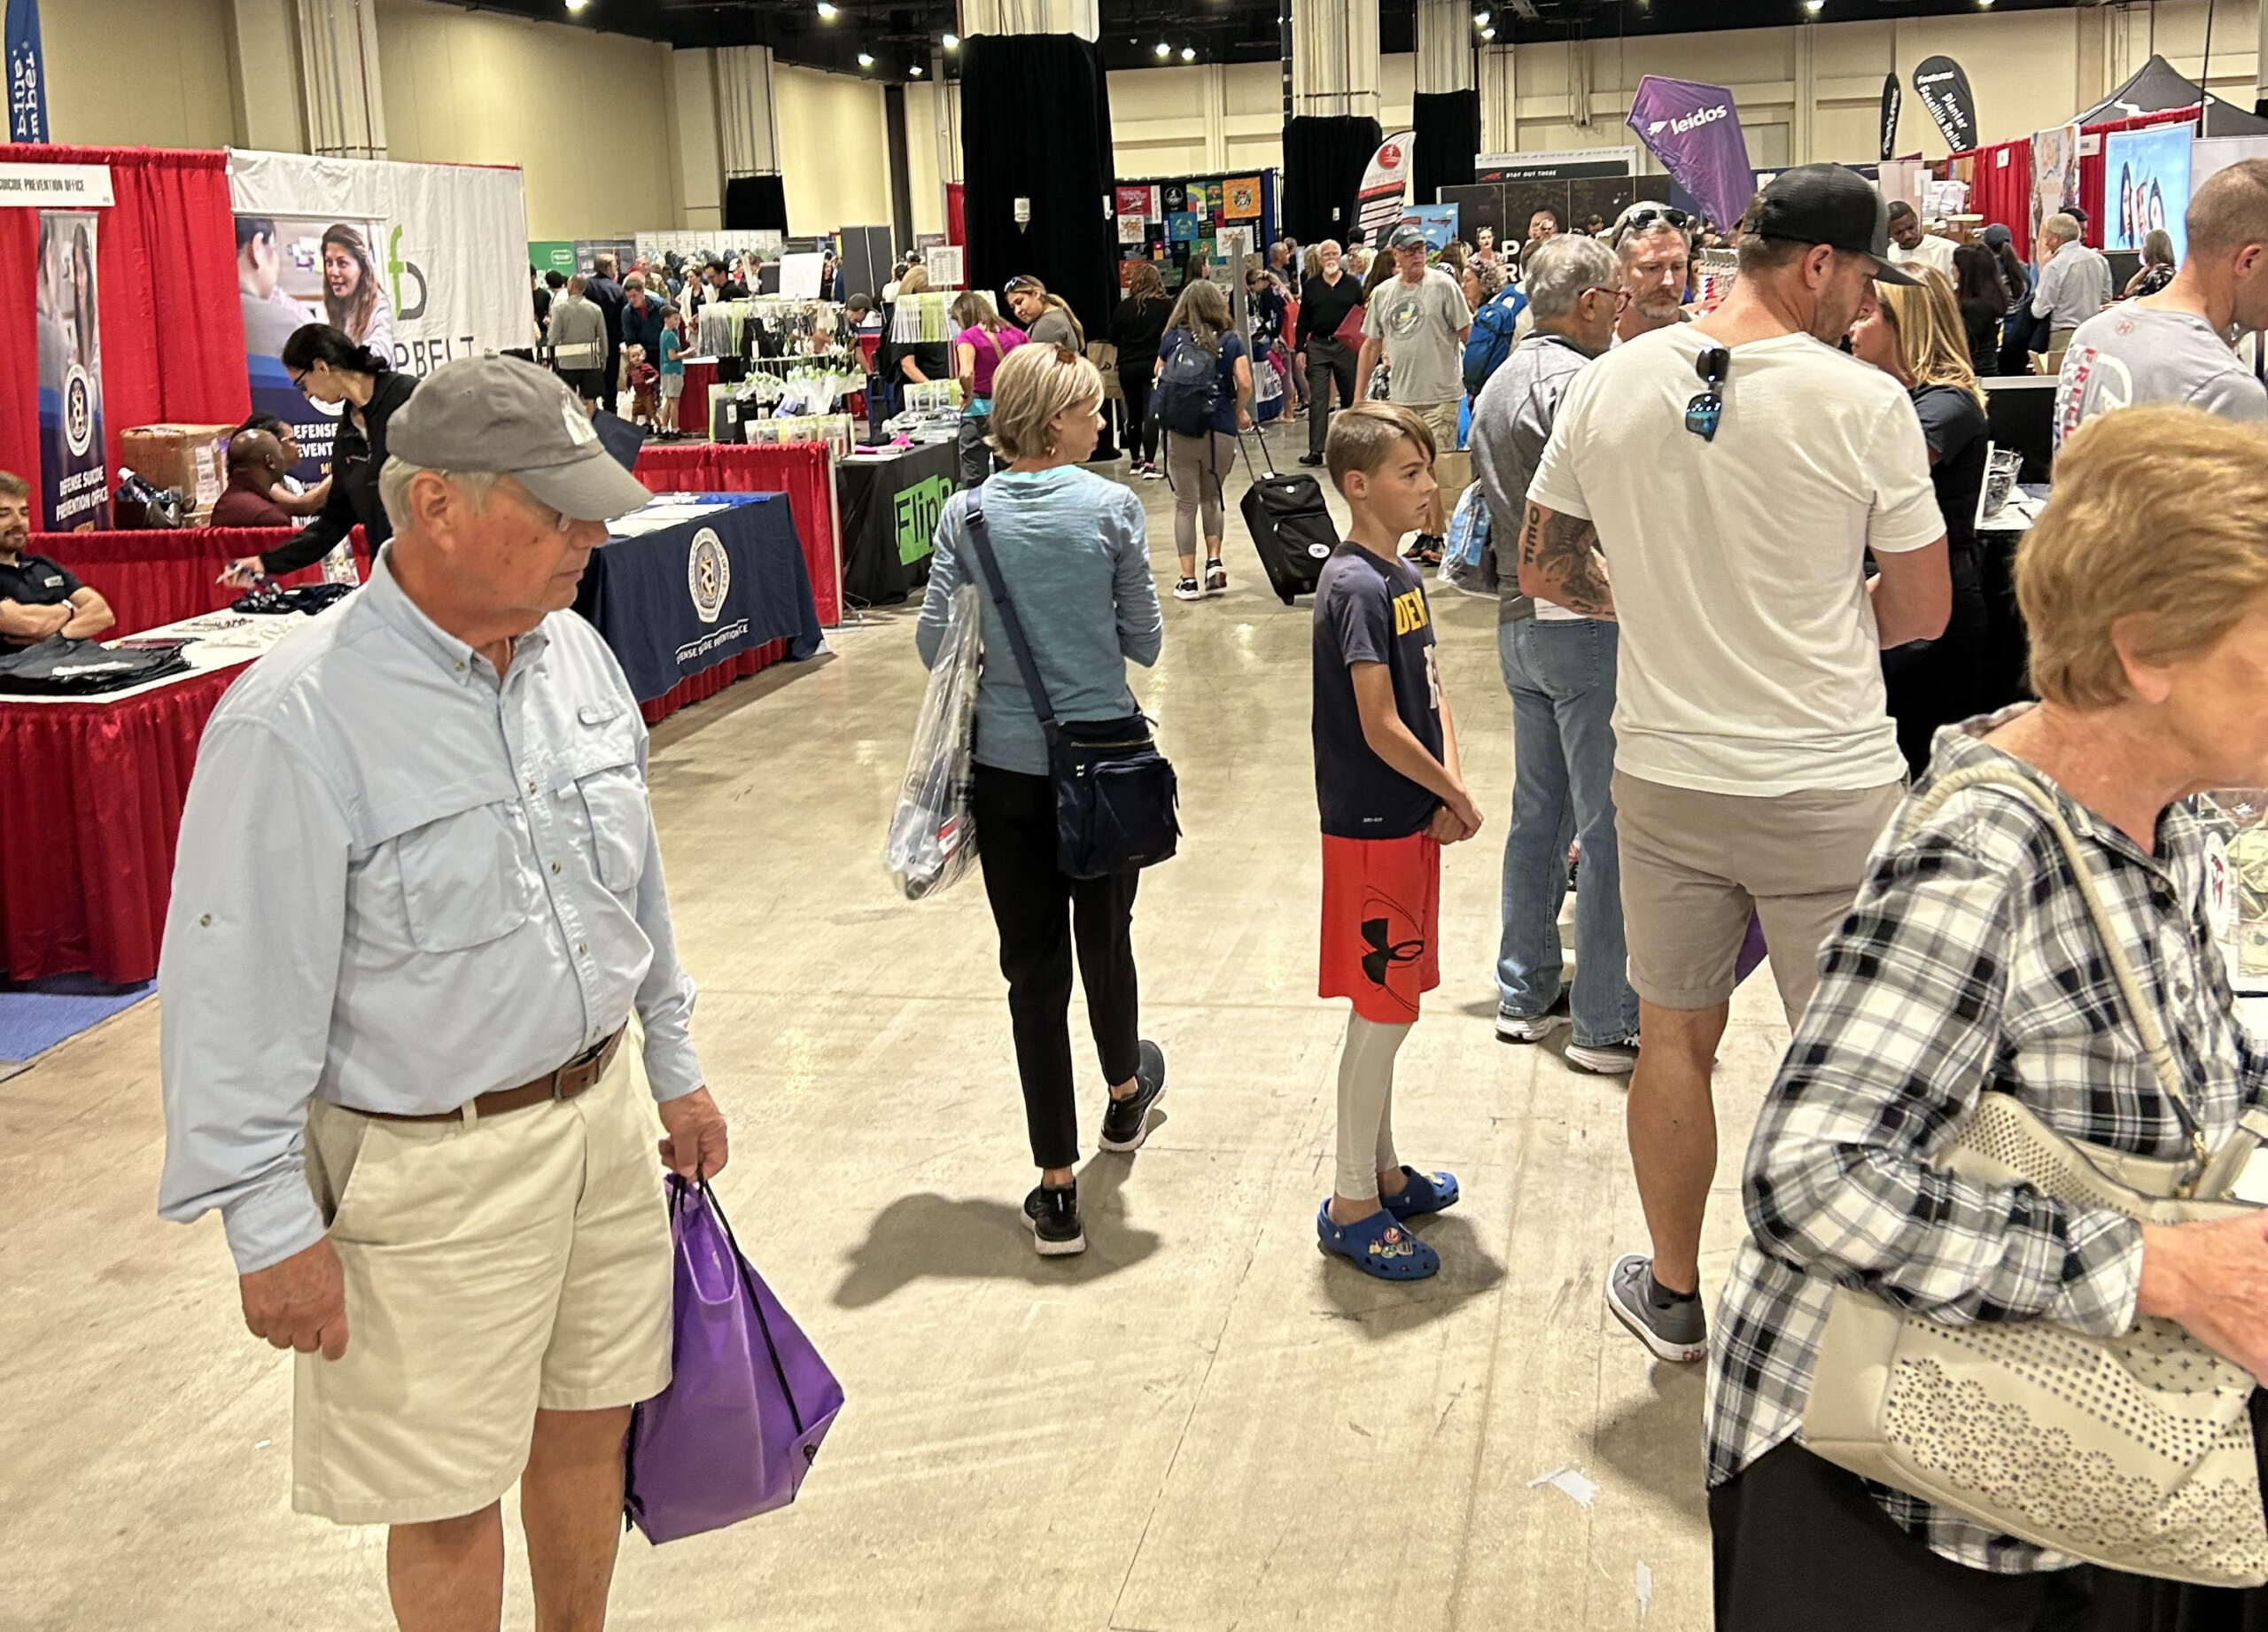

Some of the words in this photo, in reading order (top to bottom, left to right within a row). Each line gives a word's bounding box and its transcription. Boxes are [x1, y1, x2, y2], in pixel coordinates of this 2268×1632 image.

[1670, 105, 1728, 135] leidos
[24, 179, 63, 191] PREVENTION
[64, 179, 85, 192] OFFICE
[293, 422, 339, 439] EFENSE
